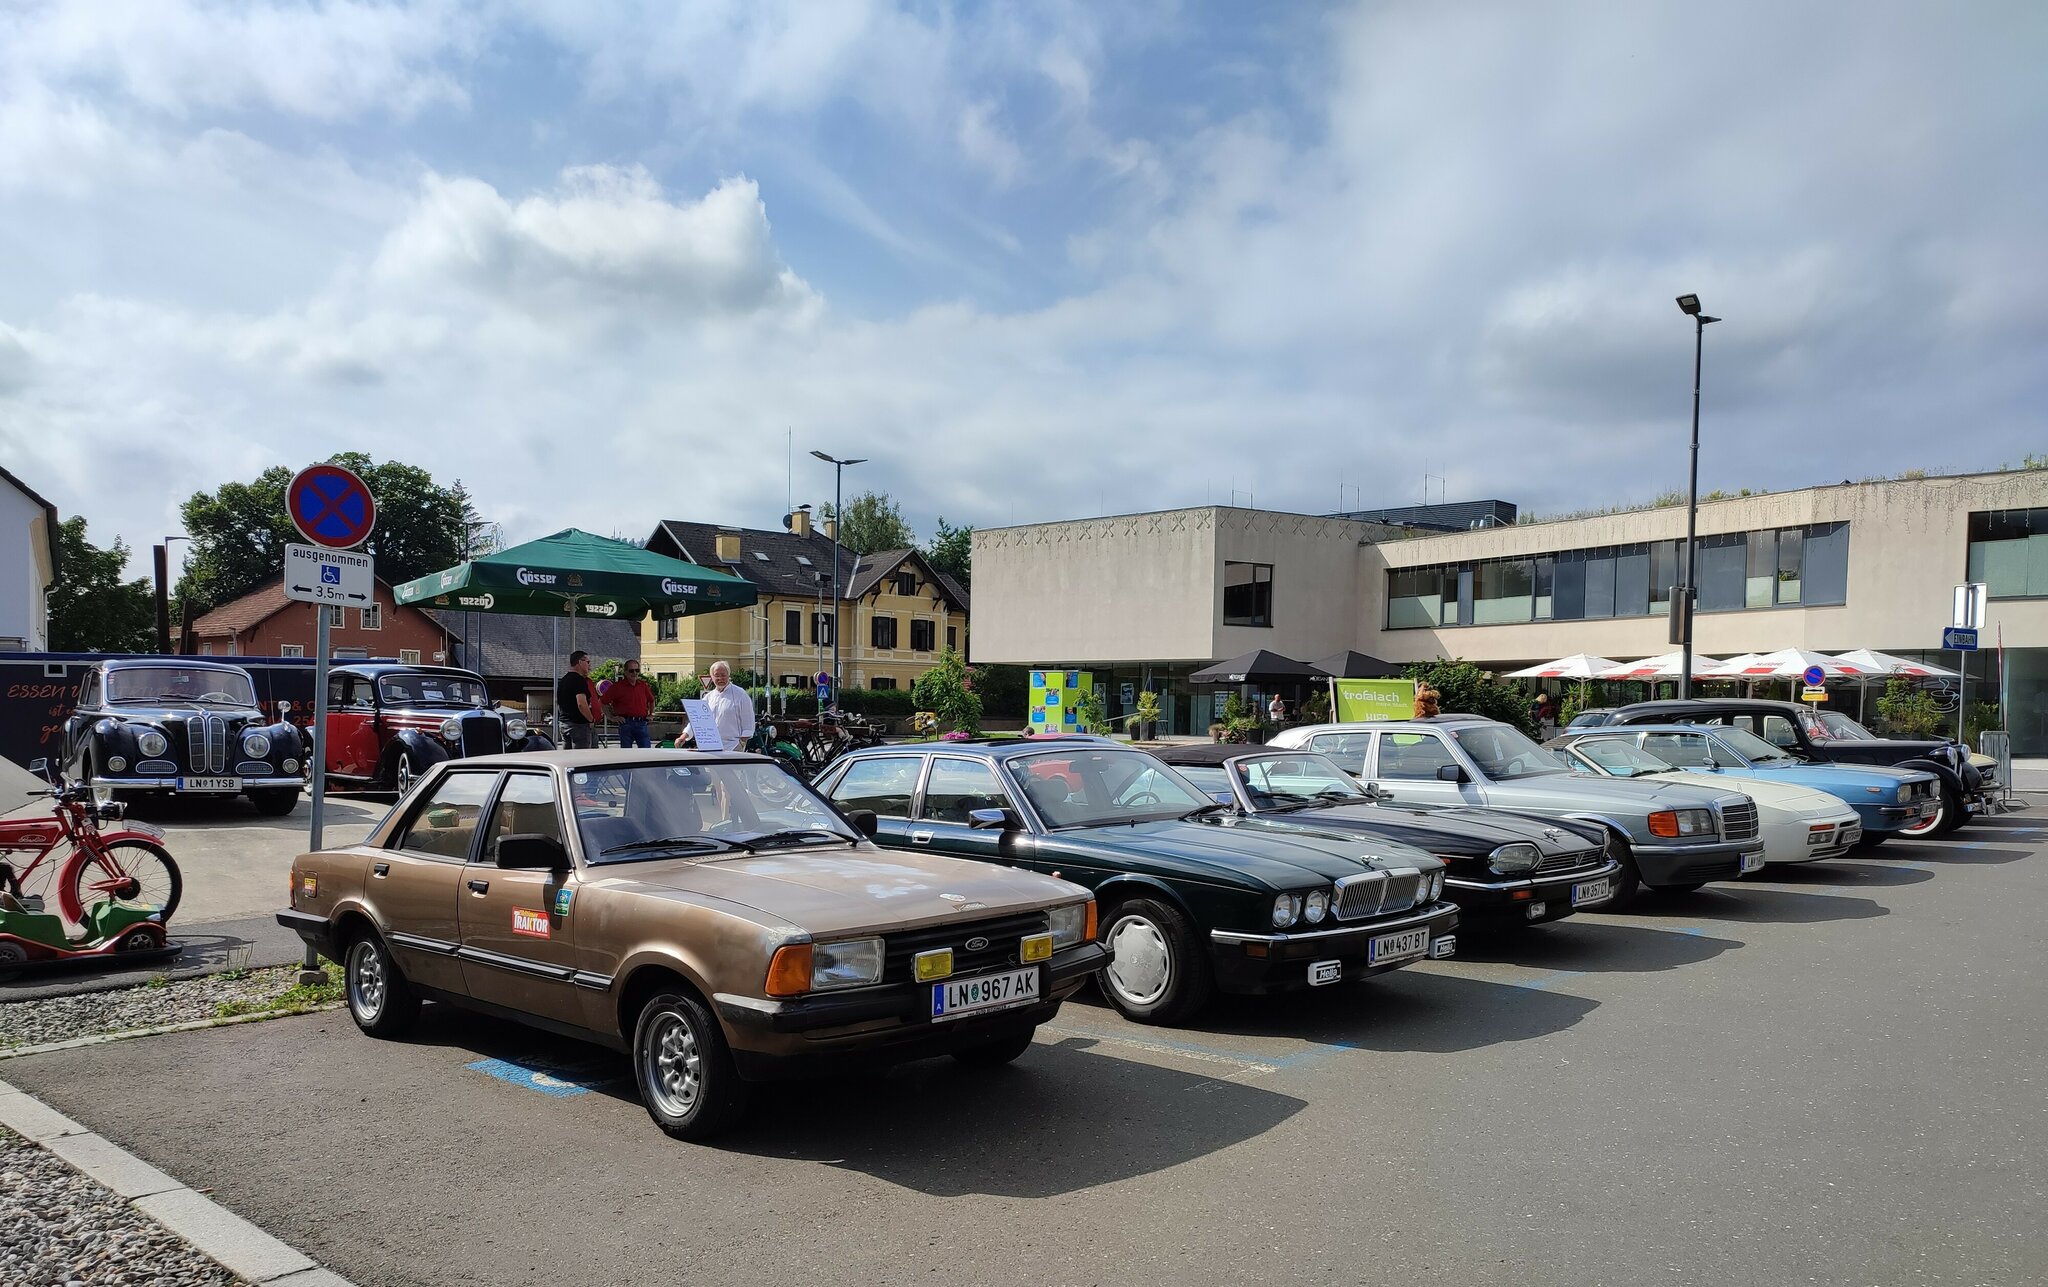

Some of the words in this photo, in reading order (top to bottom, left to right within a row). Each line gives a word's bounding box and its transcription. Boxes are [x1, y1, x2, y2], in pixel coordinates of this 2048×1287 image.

[292, 548, 368, 568] ausgenommen
[516, 567, 557, 586] Gösser
[315, 585, 345, 600] 3,5m
[661, 577, 698, 596] Gösser
[7, 684, 66, 698] ESSEN
[1343, 690, 1400, 703] trofaiach
[190, 779, 202, 788] LN
[513, 910, 549, 934] TRAKTOR
[1377, 938, 1390, 956] LN
[1395, 935, 1413, 952] 437
[1414, 931, 1426, 949] BT
[1320, 968, 1338, 979] Hella
[949, 984, 969, 1008] LN
[981, 977, 1011, 1002] 967
[1015, 972, 1034, 995] AK
